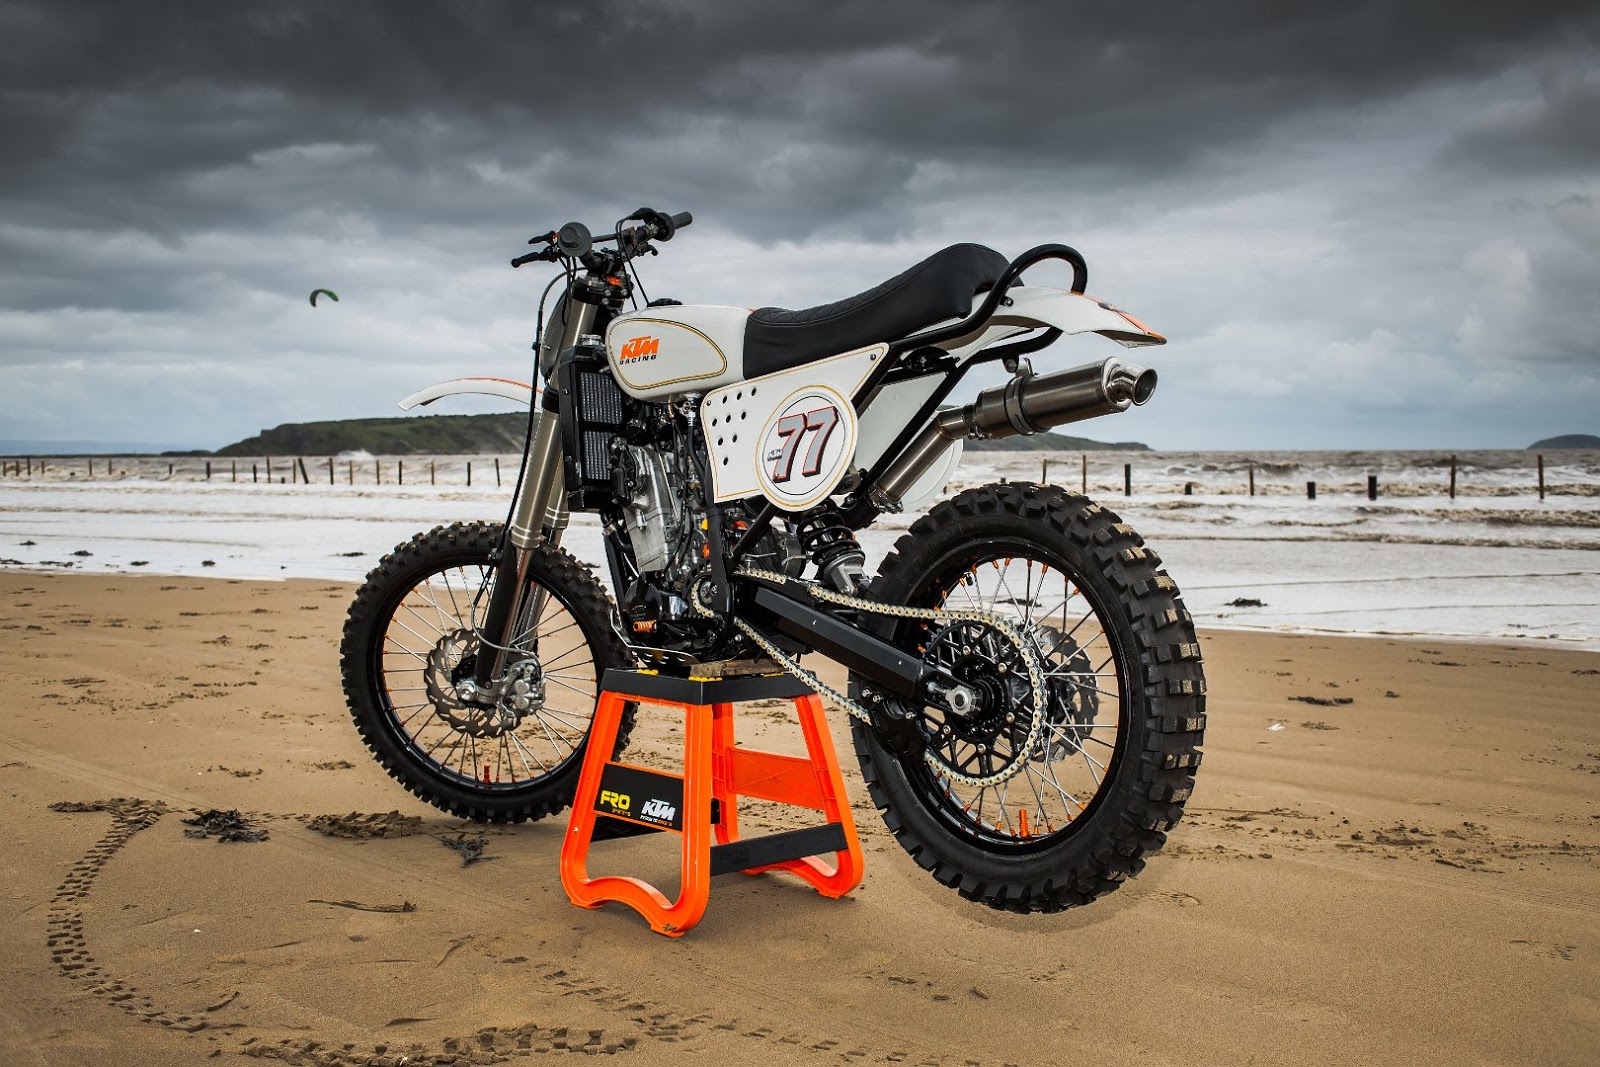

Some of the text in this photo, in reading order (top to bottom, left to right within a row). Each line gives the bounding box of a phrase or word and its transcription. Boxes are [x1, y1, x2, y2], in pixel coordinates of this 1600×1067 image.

[620, 335, 660, 360] KTM
[619, 355, 657, 365] RACING
[772, 405, 839, 484] 77
[600, 789, 631, 811] FRO
[641, 798, 676, 821] KTM
